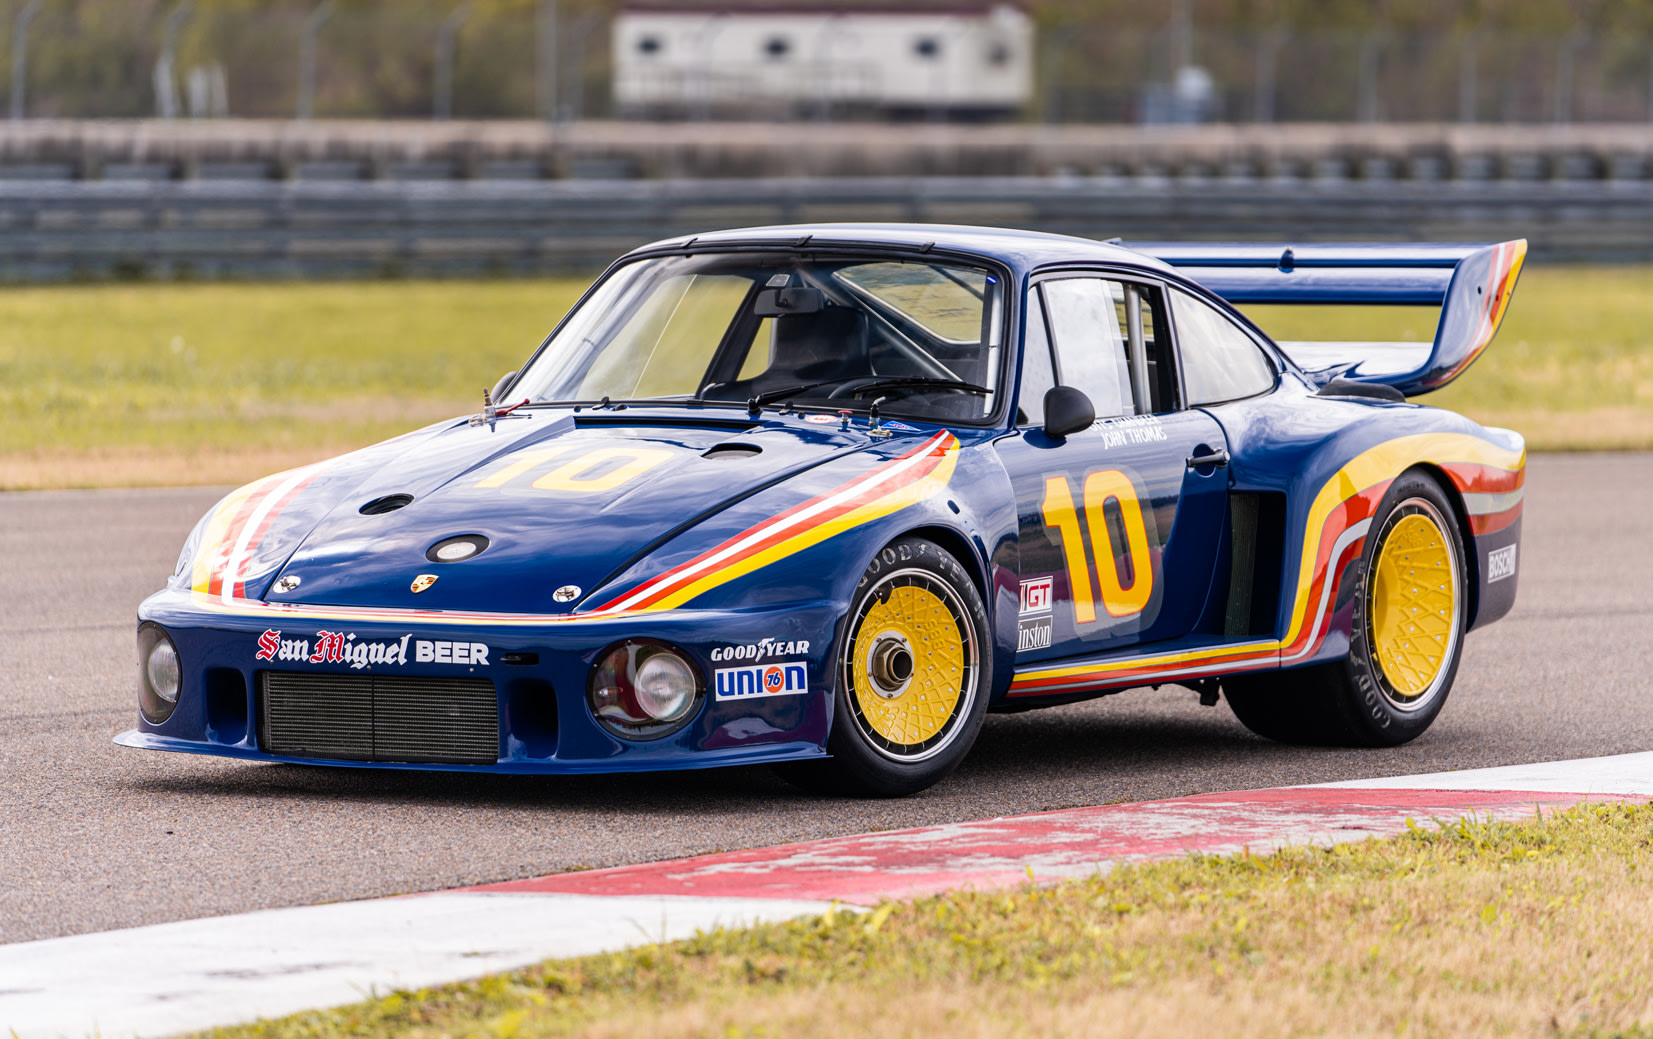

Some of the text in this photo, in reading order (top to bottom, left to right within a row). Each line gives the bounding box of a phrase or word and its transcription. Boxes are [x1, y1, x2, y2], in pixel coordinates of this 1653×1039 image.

[1101, 425, 1168, 450] JOHN THOMAS
[472, 446, 676, 492] 10
[1041, 469, 1153, 624] 10
[255, 628, 490, 670] San Miguel BEER
[710, 639, 810, 662] GOODYEAR
[1018, 622, 1050, 650] inston
[717, 665, 805, 697] UNION
[766, 671, 781, 687] 76
